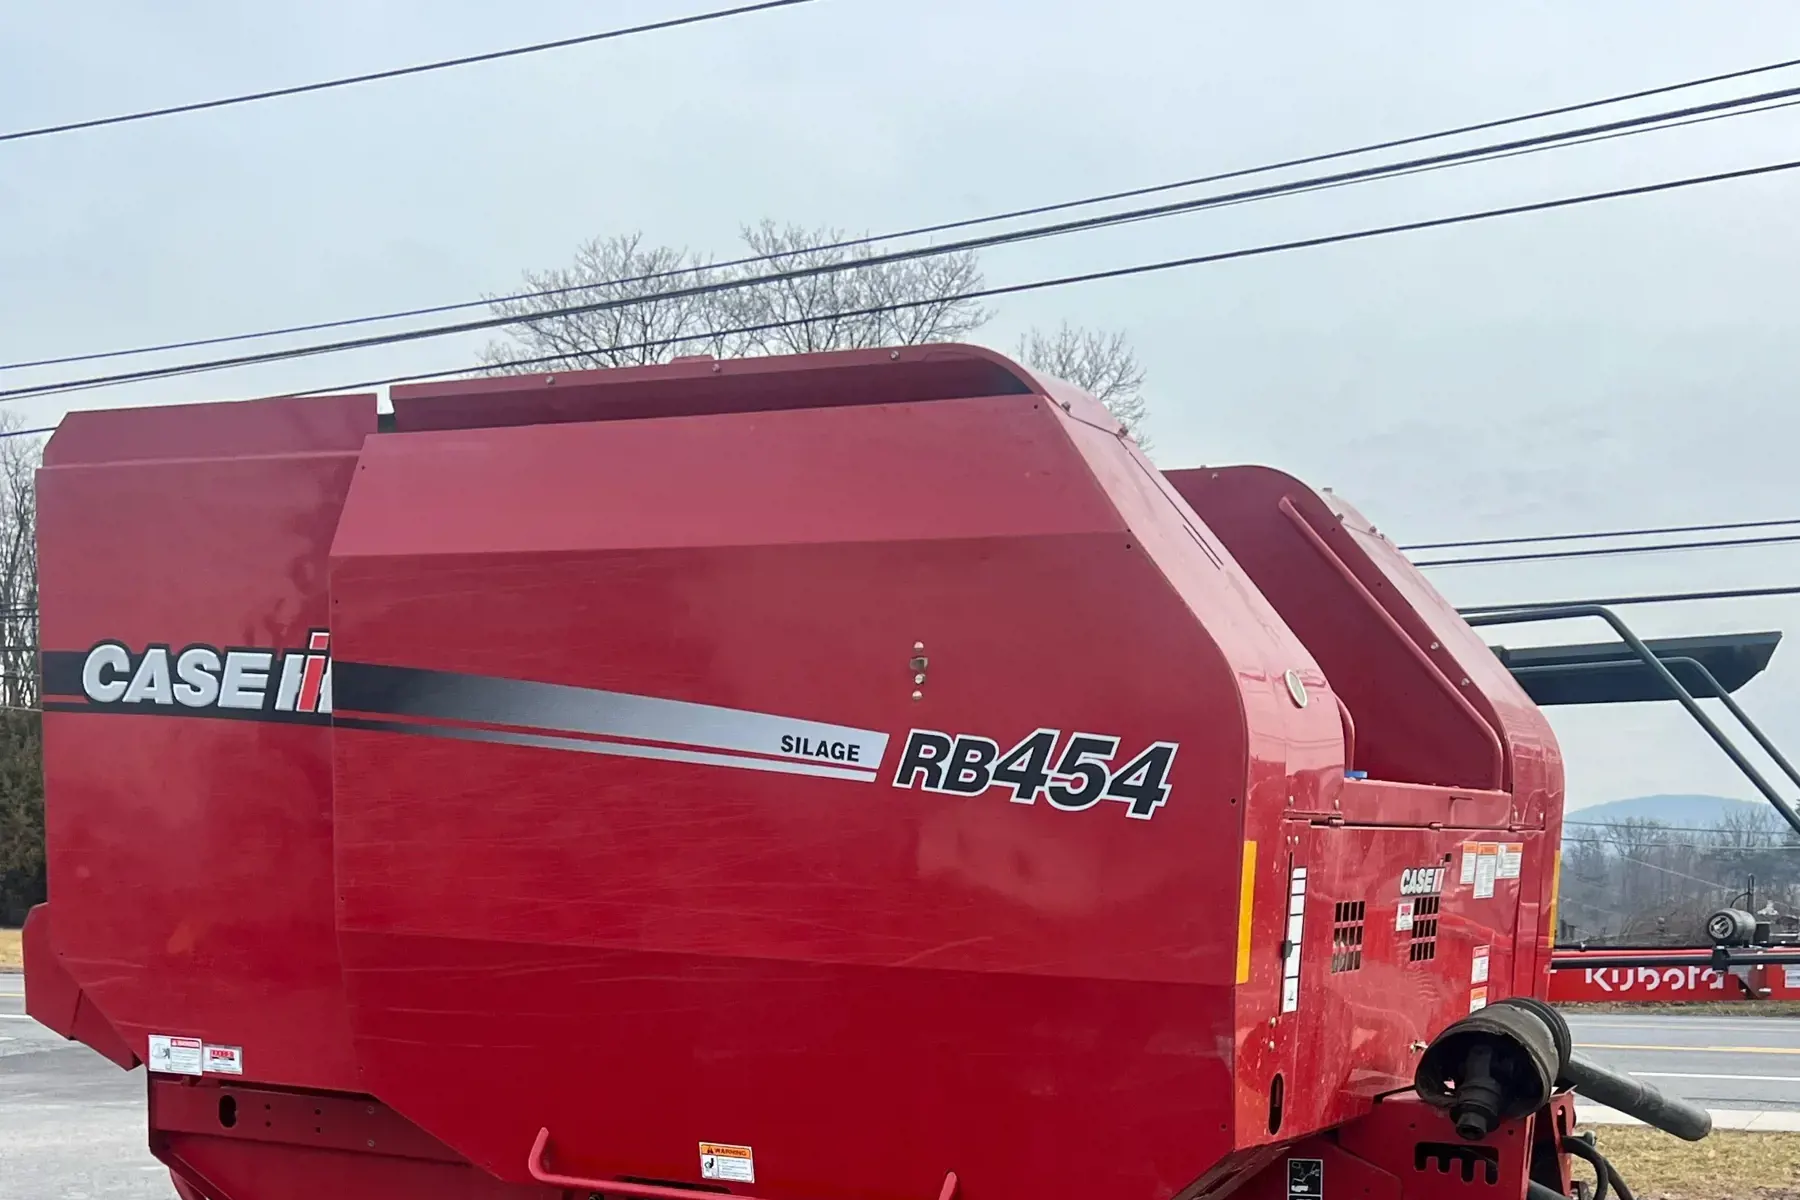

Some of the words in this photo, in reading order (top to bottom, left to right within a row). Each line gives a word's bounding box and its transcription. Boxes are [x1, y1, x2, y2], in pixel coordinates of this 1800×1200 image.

[82, 643, 273, 708] CASE
[780, 734, 861, 763] SILAGE
[892, 728, 1180, 821] RB454
[1400, 868, 1435, 895] CASE
